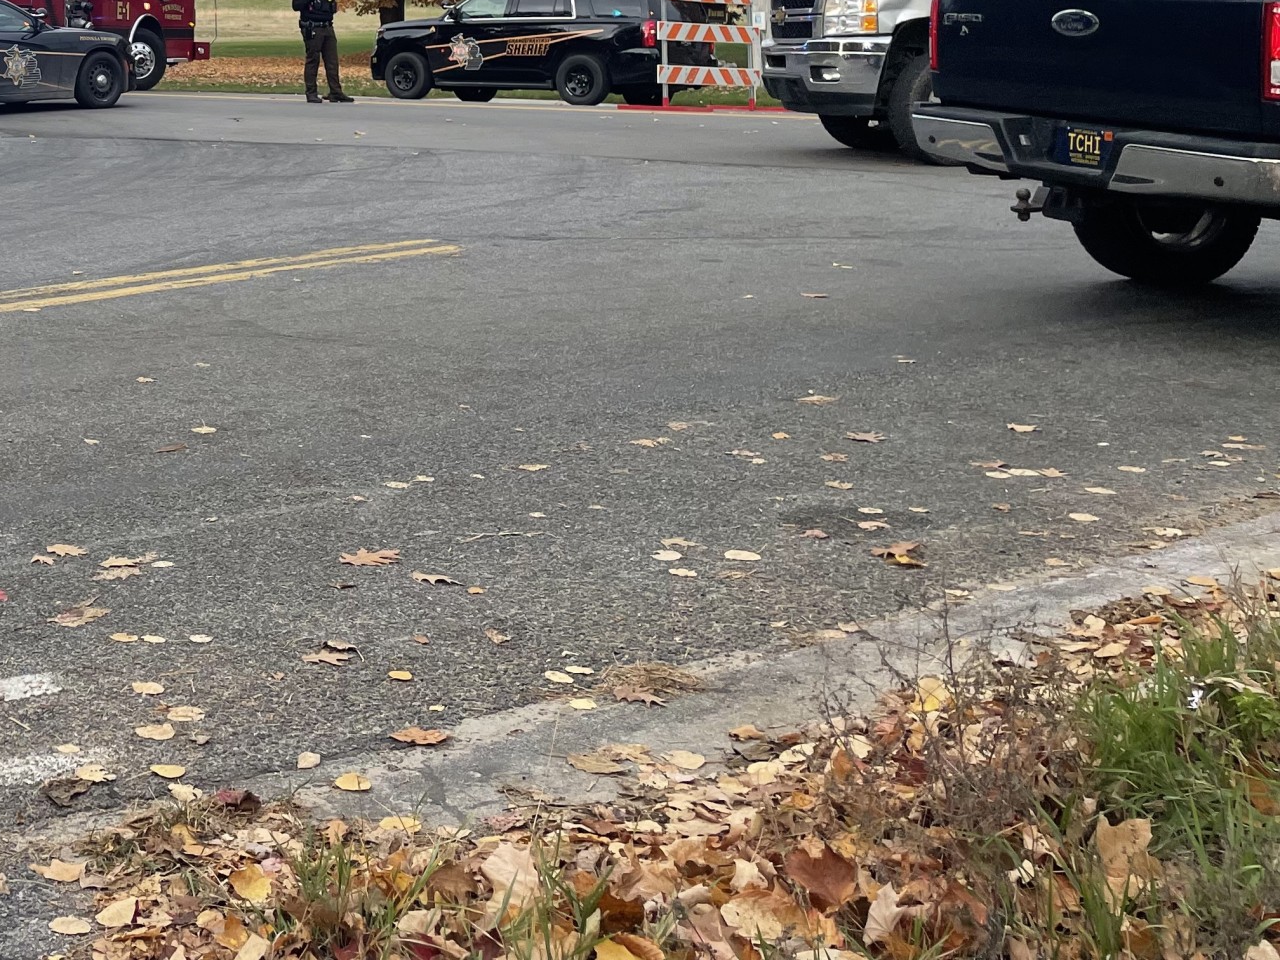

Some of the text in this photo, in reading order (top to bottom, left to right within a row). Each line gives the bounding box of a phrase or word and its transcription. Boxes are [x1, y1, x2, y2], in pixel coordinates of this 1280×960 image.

[117, 1, 130, 21] E-1
[506, 42, 550, 56] SHERIFF
[1068, 132, 1101, 155] TCHI
